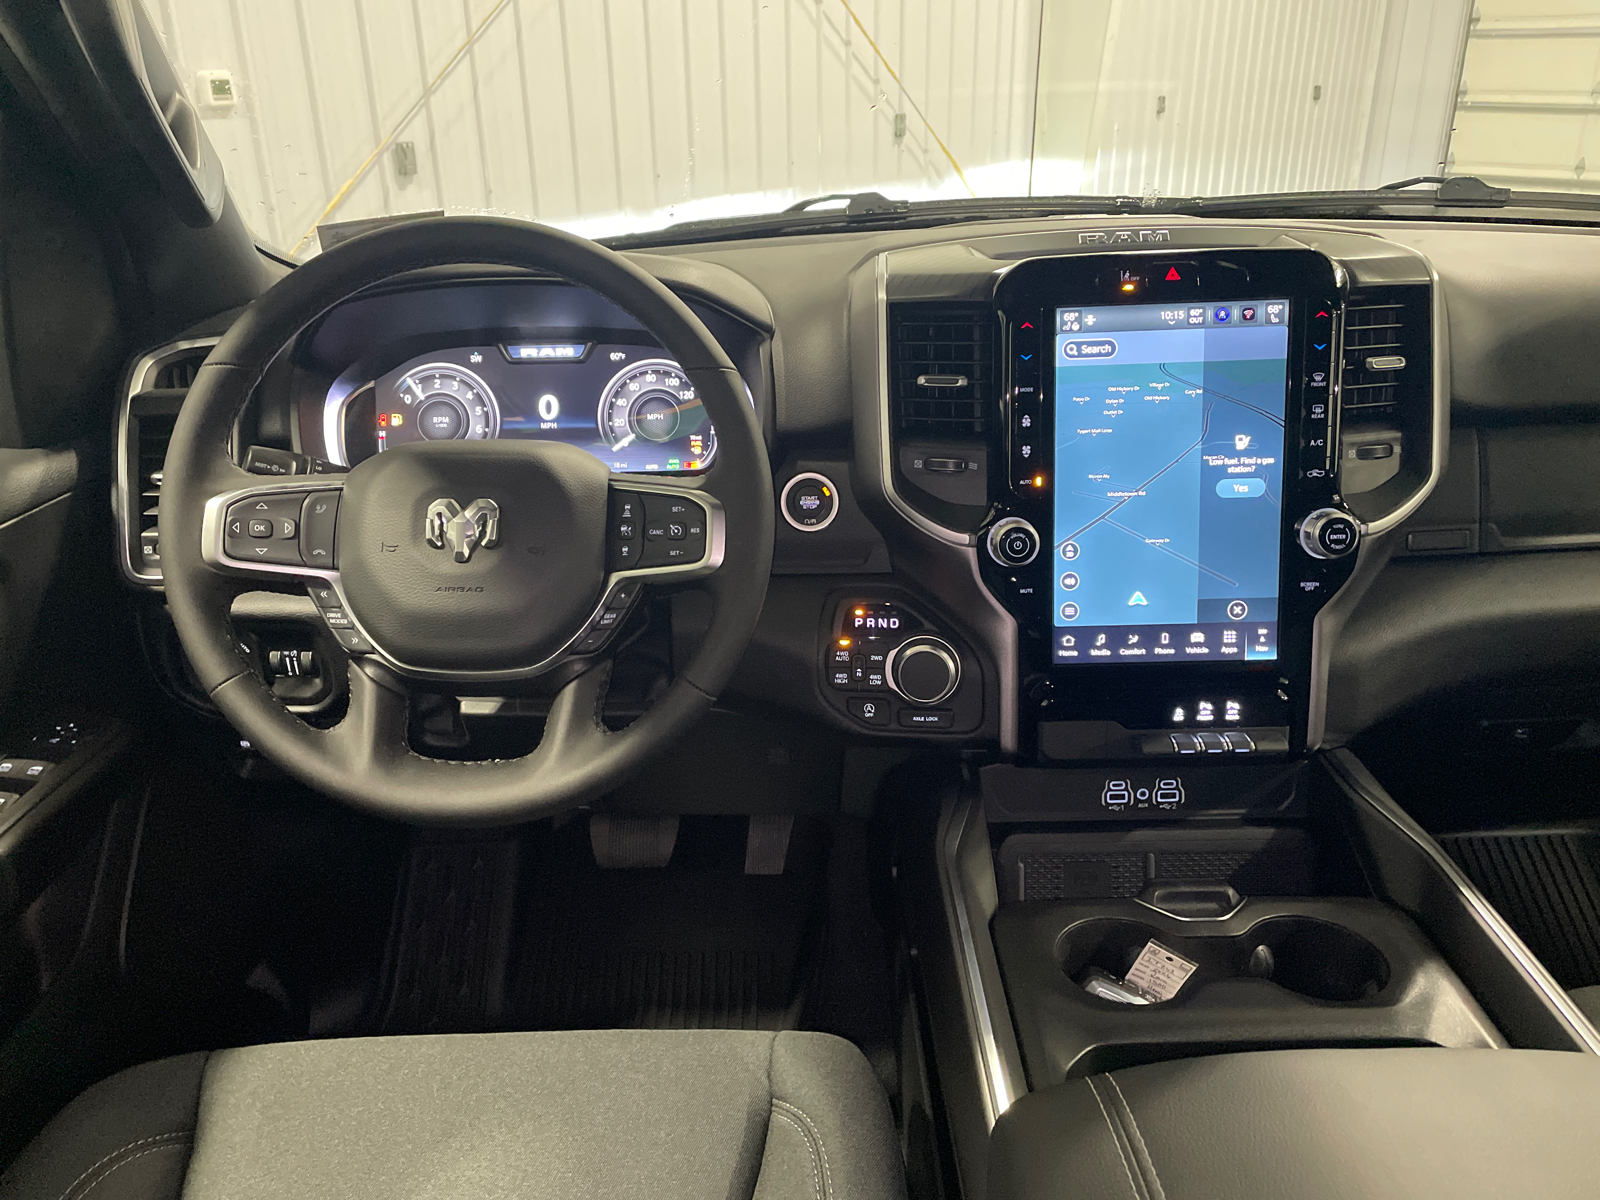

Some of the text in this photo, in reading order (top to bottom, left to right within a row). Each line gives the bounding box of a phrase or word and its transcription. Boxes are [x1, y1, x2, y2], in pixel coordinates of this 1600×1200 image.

[1078, 230, 1171, 245] RAM
[1161, 311, 1184, 320] 10:15
[520, 347, 574, 358] RAM
[1081, 344, 1112, 354] Search
[470, 355, 482, 363] SW
[645, 374, 657, 382] 80
[665, 378, 680, 386] 100
[434, 379, 441, 388] 2
[452, 381, 459, 391] 3
[629, 383, 640, 391] 60
[404, 395, 412, 404] 0
[466, 391, 474, 400] 4
[679, 391, 695, 399] 120
[538, 394, 559, 420] 0
[616, 398, 627, 407] 40
[475, 406, 482, 416] 5
[433, 416, 449, 424] RPM
[614, 418, 625, 427] 20
[475, 425, 483, 434] 6
[540, 421, 558, 429] MPH
[1209, 458, 1223, 466] Low
[1224, 457, 1240, 465] fuel.
[1261, 457, 1275, 466] gas
[1227, 465, 1256, 473] station?
[1233, 484, 1249, 493] Yes
[854, 618, 900, 629] P R N D
[1059, 649, 1079, 657] Home
[1090, 648, 1112, 656] Media
[1119, 648, 1146, 656] Comfort
[1154, 647, 1176, 655] Phone
[1185, 646, 1210, 654] Vehicle
[1220, 646, 1238, 654] Apps
